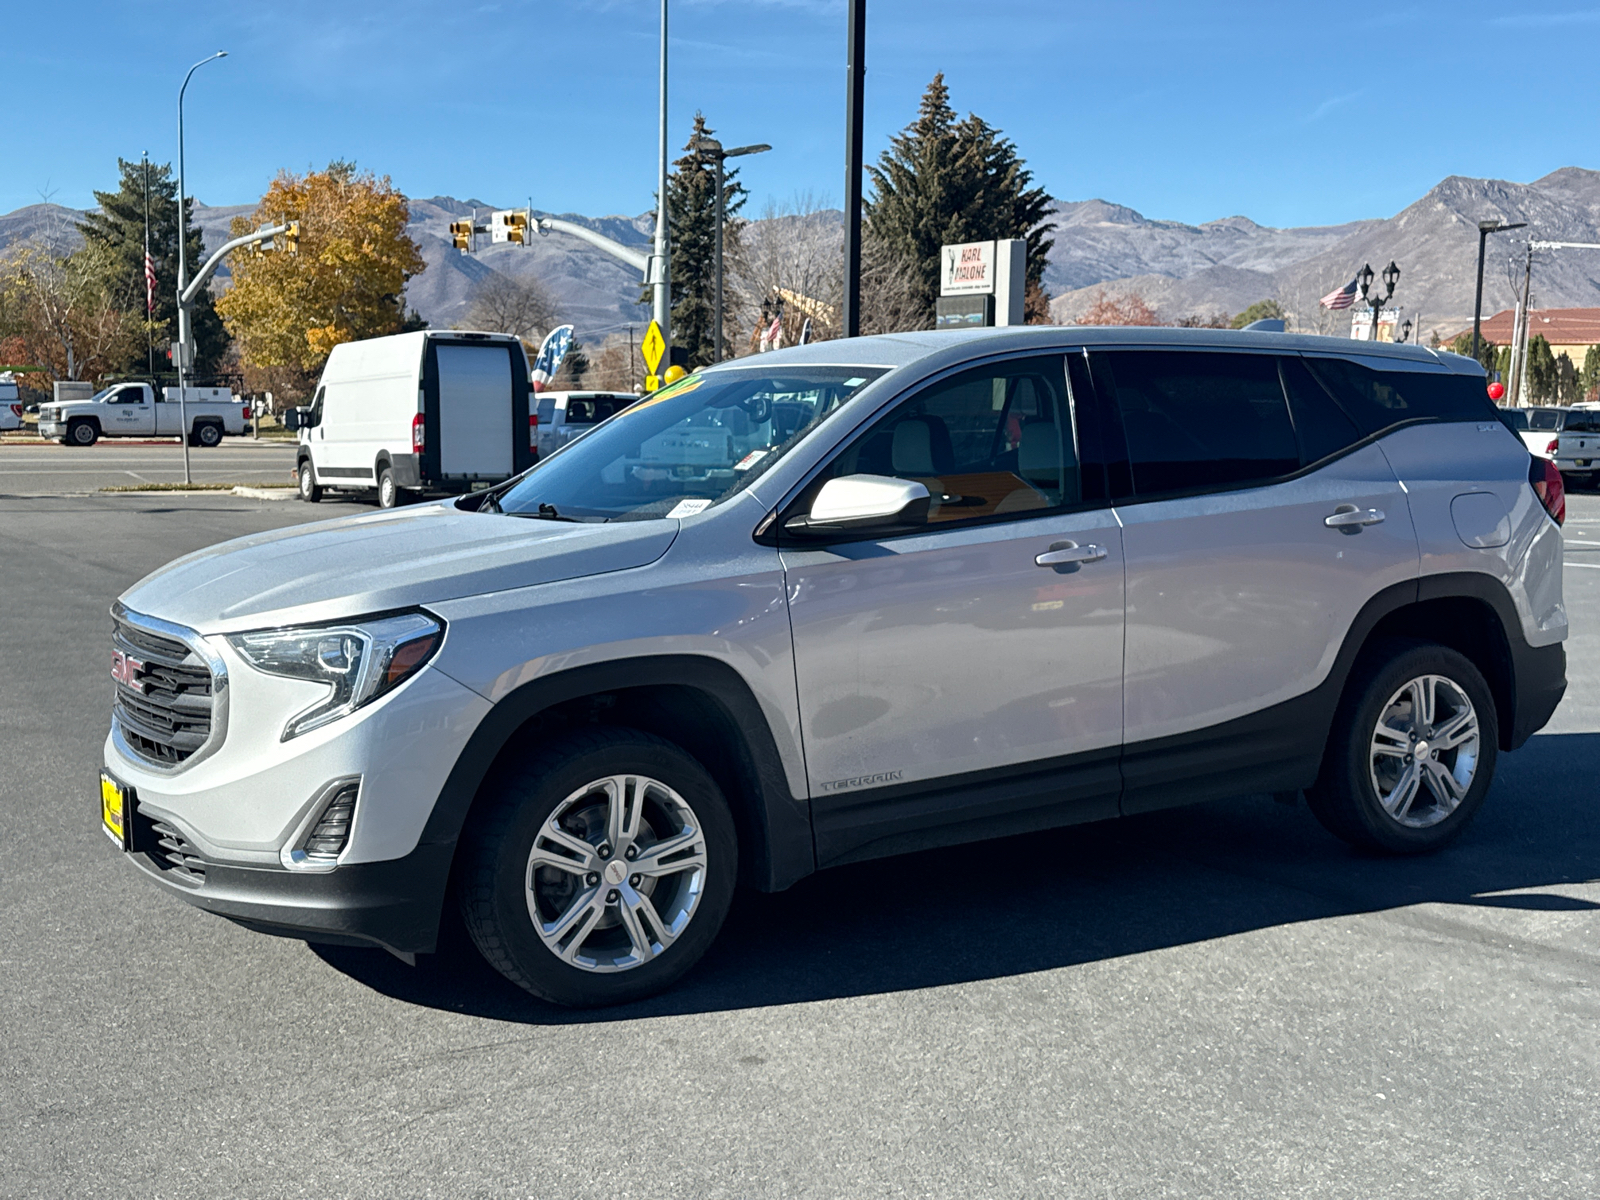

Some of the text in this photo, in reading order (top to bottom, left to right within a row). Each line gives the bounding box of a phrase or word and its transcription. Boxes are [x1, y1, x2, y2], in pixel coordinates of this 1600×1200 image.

[961, 247, 982, 263] KARL
[954, 264, 987, 281] MALONE
[110, 648, 144, 692] GMC
[820, 770, 904, 791] TERRAIN
